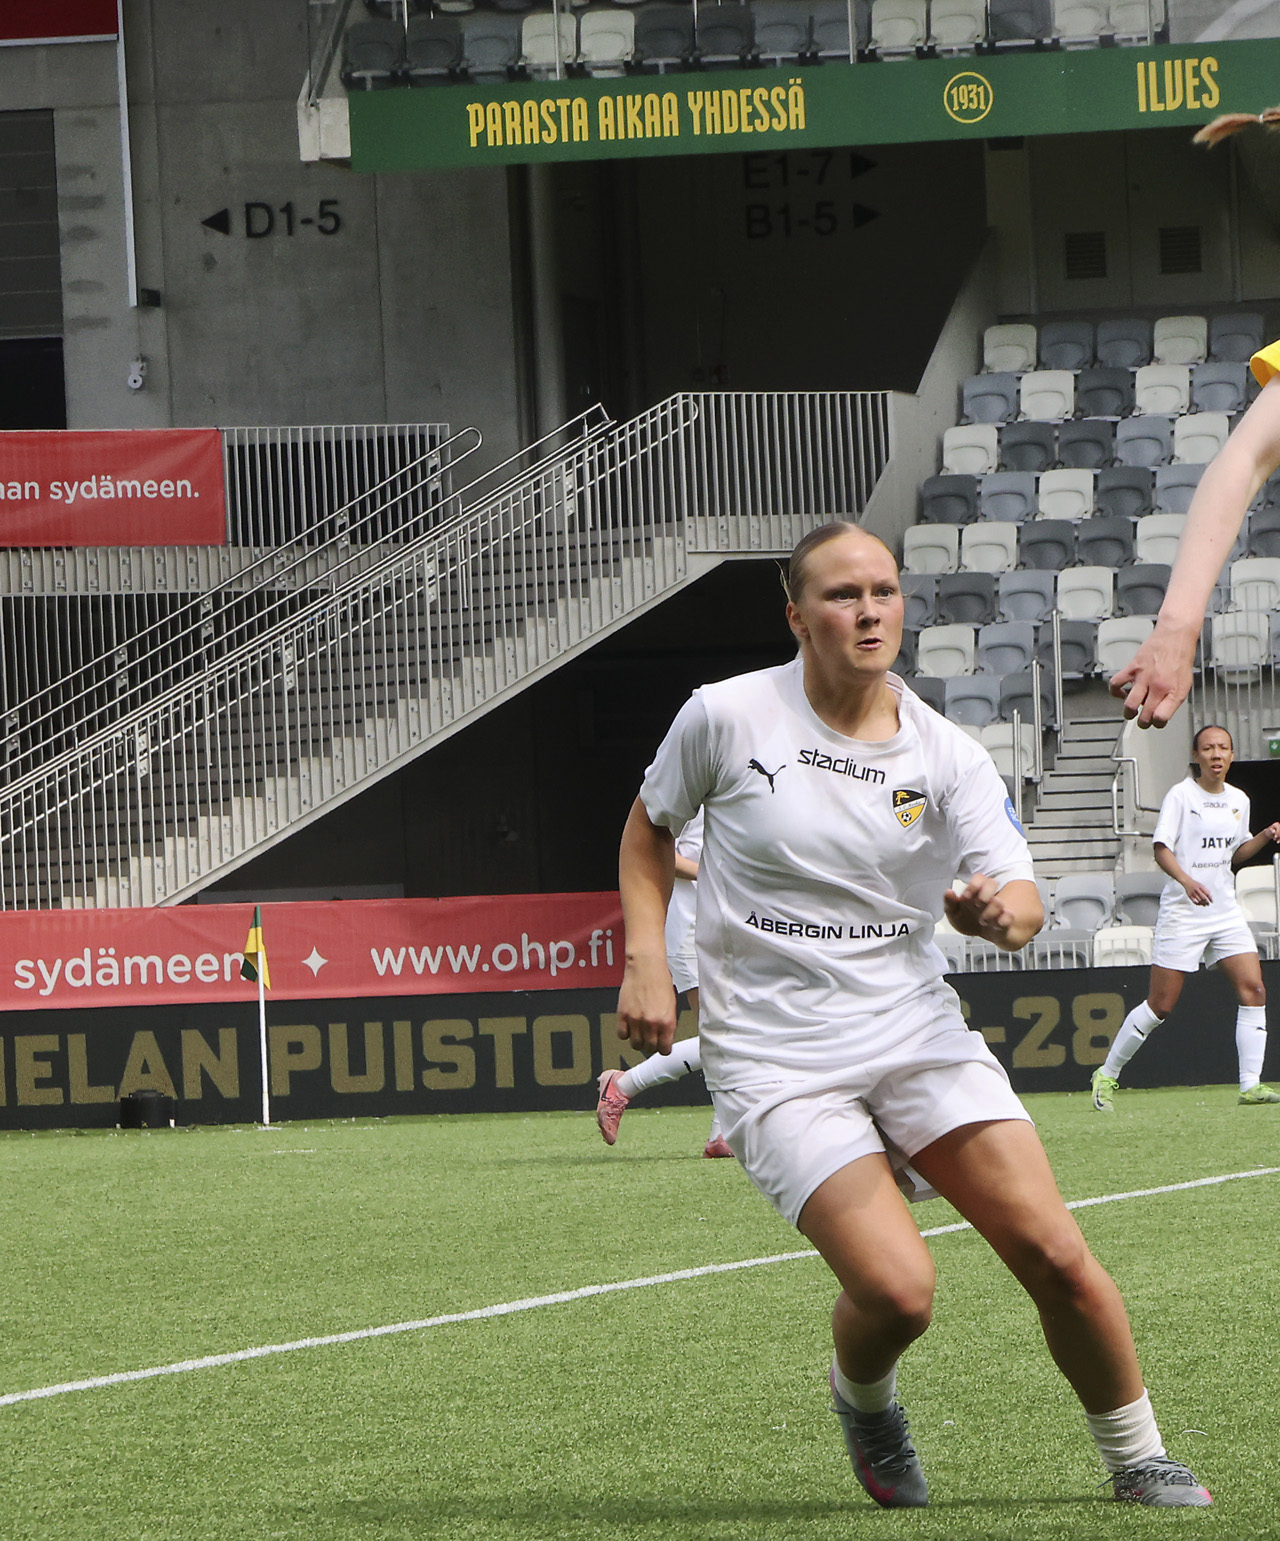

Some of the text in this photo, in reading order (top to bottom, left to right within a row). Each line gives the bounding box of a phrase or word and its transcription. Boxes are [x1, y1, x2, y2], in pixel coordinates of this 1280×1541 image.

[949, 83, 987, 112] 1931
[1136, 56, 1220, 113] ILVES
[466, 78, 806, 147] PARASTA AIKAA YHDESSÄ
[742, 151, 834, 189] E1-7
[245, 199, 342, 238] D1-5
[745, 200, 839, 240] B1-5
[0, 475, 200, 504] an sydämeen.
[797, 748, 886, 785] stadium
[744, 911, 910, 939] ÅBERGIN LINJA
[14, 929, 614, 996] sydämeen www.ohp.fi
[0, 1027, 241, 1107] ELAN
[961, 992, 1125, 1069] -28
